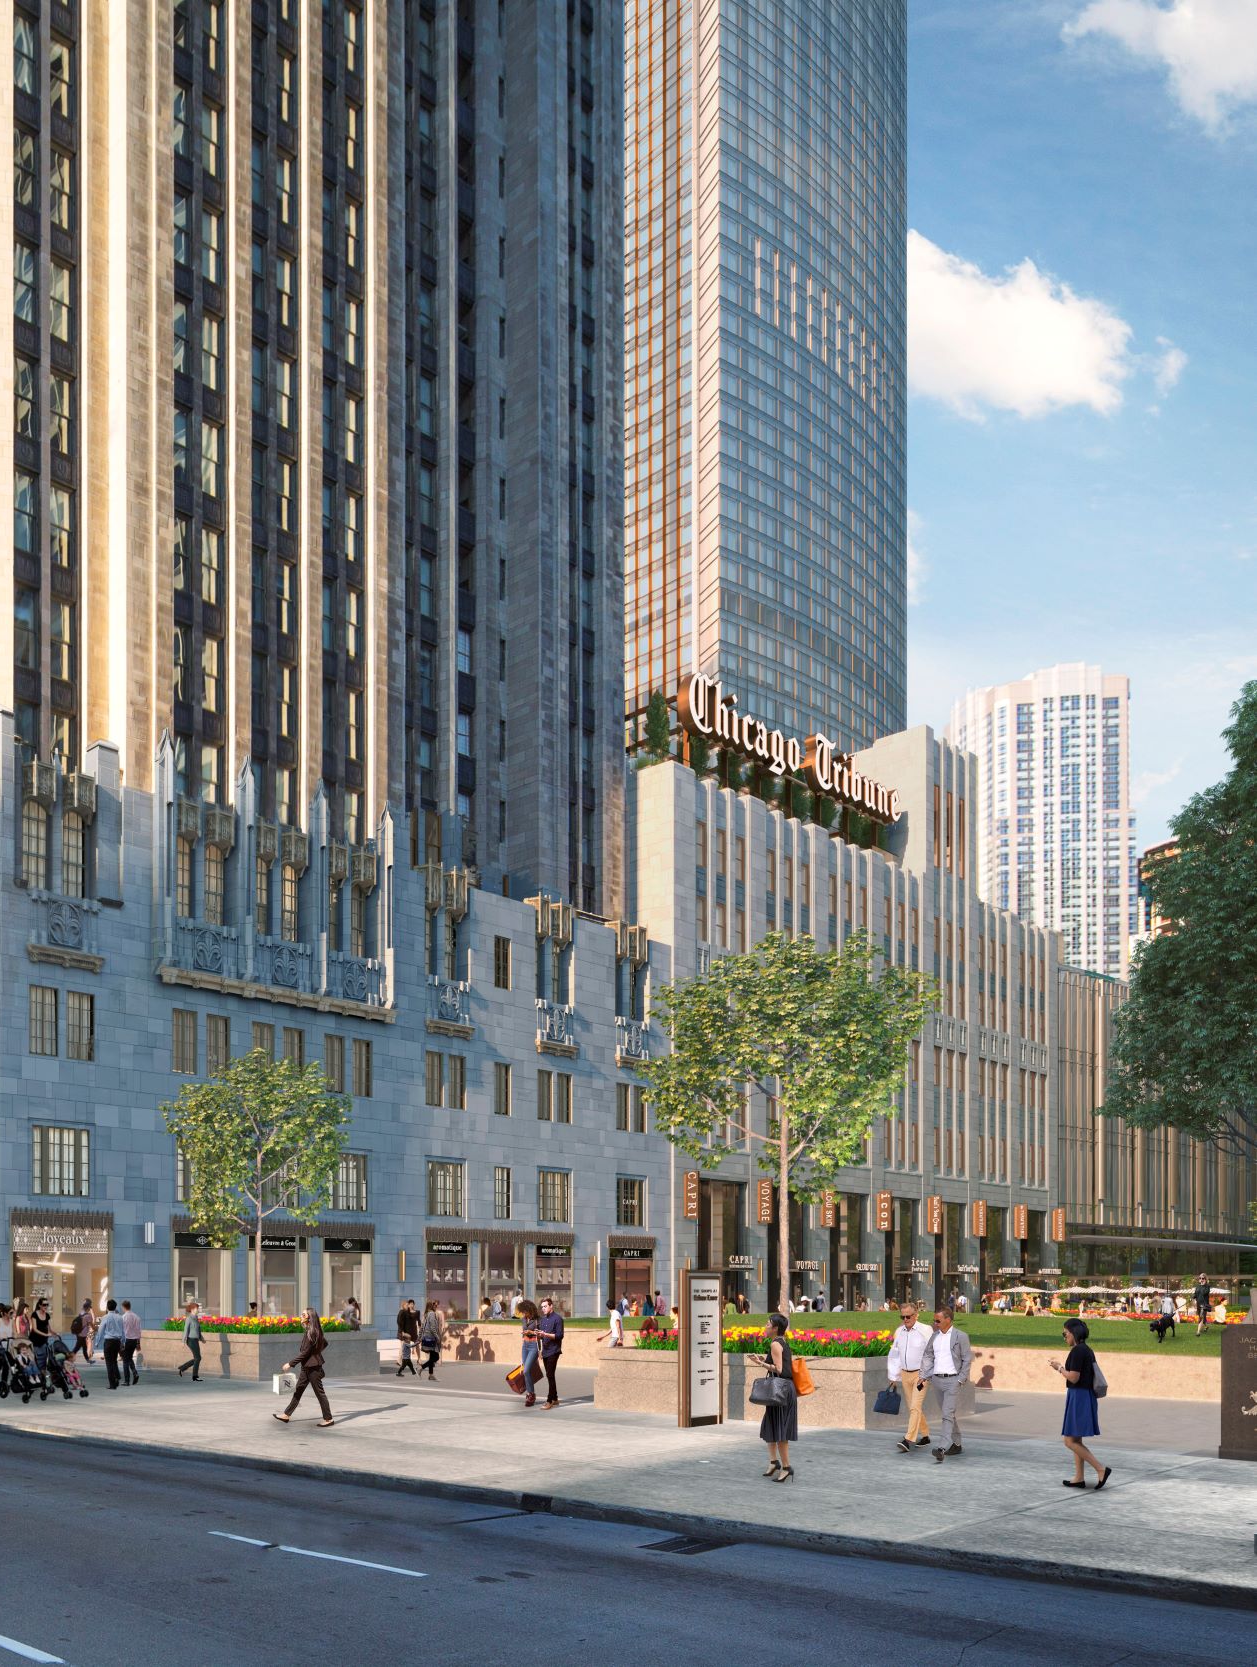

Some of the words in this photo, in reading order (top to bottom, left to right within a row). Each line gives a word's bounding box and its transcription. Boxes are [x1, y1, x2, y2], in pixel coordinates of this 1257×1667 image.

[688, 671, 801, 776] Chicago
[814, 731, 902, 822] Tribune
[688, 1171, 697, 1217] CAPRI
[761, 1181, 770, 1222] VOYAGE
[880, 1192, 890, 1229] icon
[41, 1232, 85, 1247] Joyeaux
[432, 1243, 463, 1252] aromatique
[729, 1255, 754, 1264] CAPRI
[796, 1260, 820, 1270] VOYAGE
[911, 1257, 929, 1267] icon
